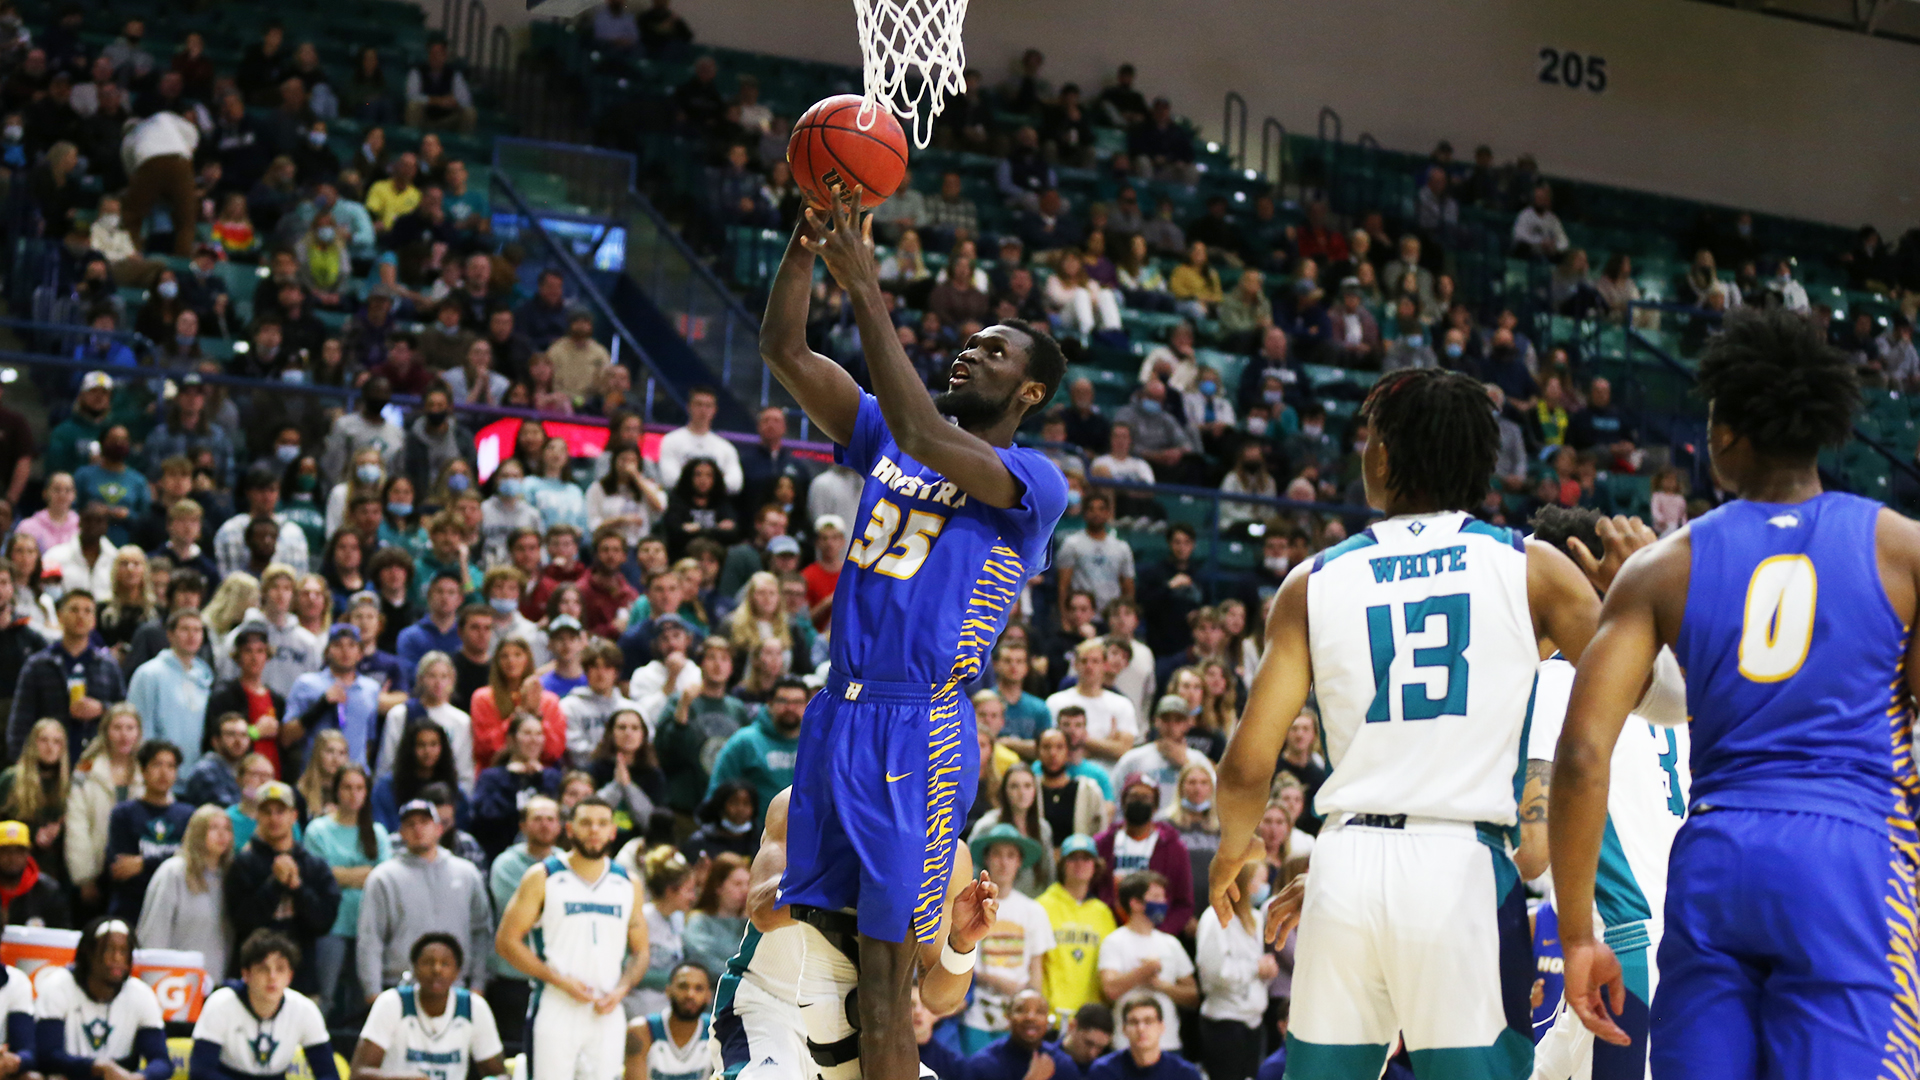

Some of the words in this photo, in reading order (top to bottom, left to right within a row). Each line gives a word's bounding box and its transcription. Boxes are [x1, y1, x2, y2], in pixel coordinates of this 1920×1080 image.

[1539, 48, 1607, 93] 205
[847, 497, 947, 580] 35
[1368, 545, 1467, 584] WHITE
[1737, 553, 1818, 683] 0
[1365, 593, 1471, 723] 13
[592, 921, 597, 945] 1
[1537, 955, 1565, 974] HO
